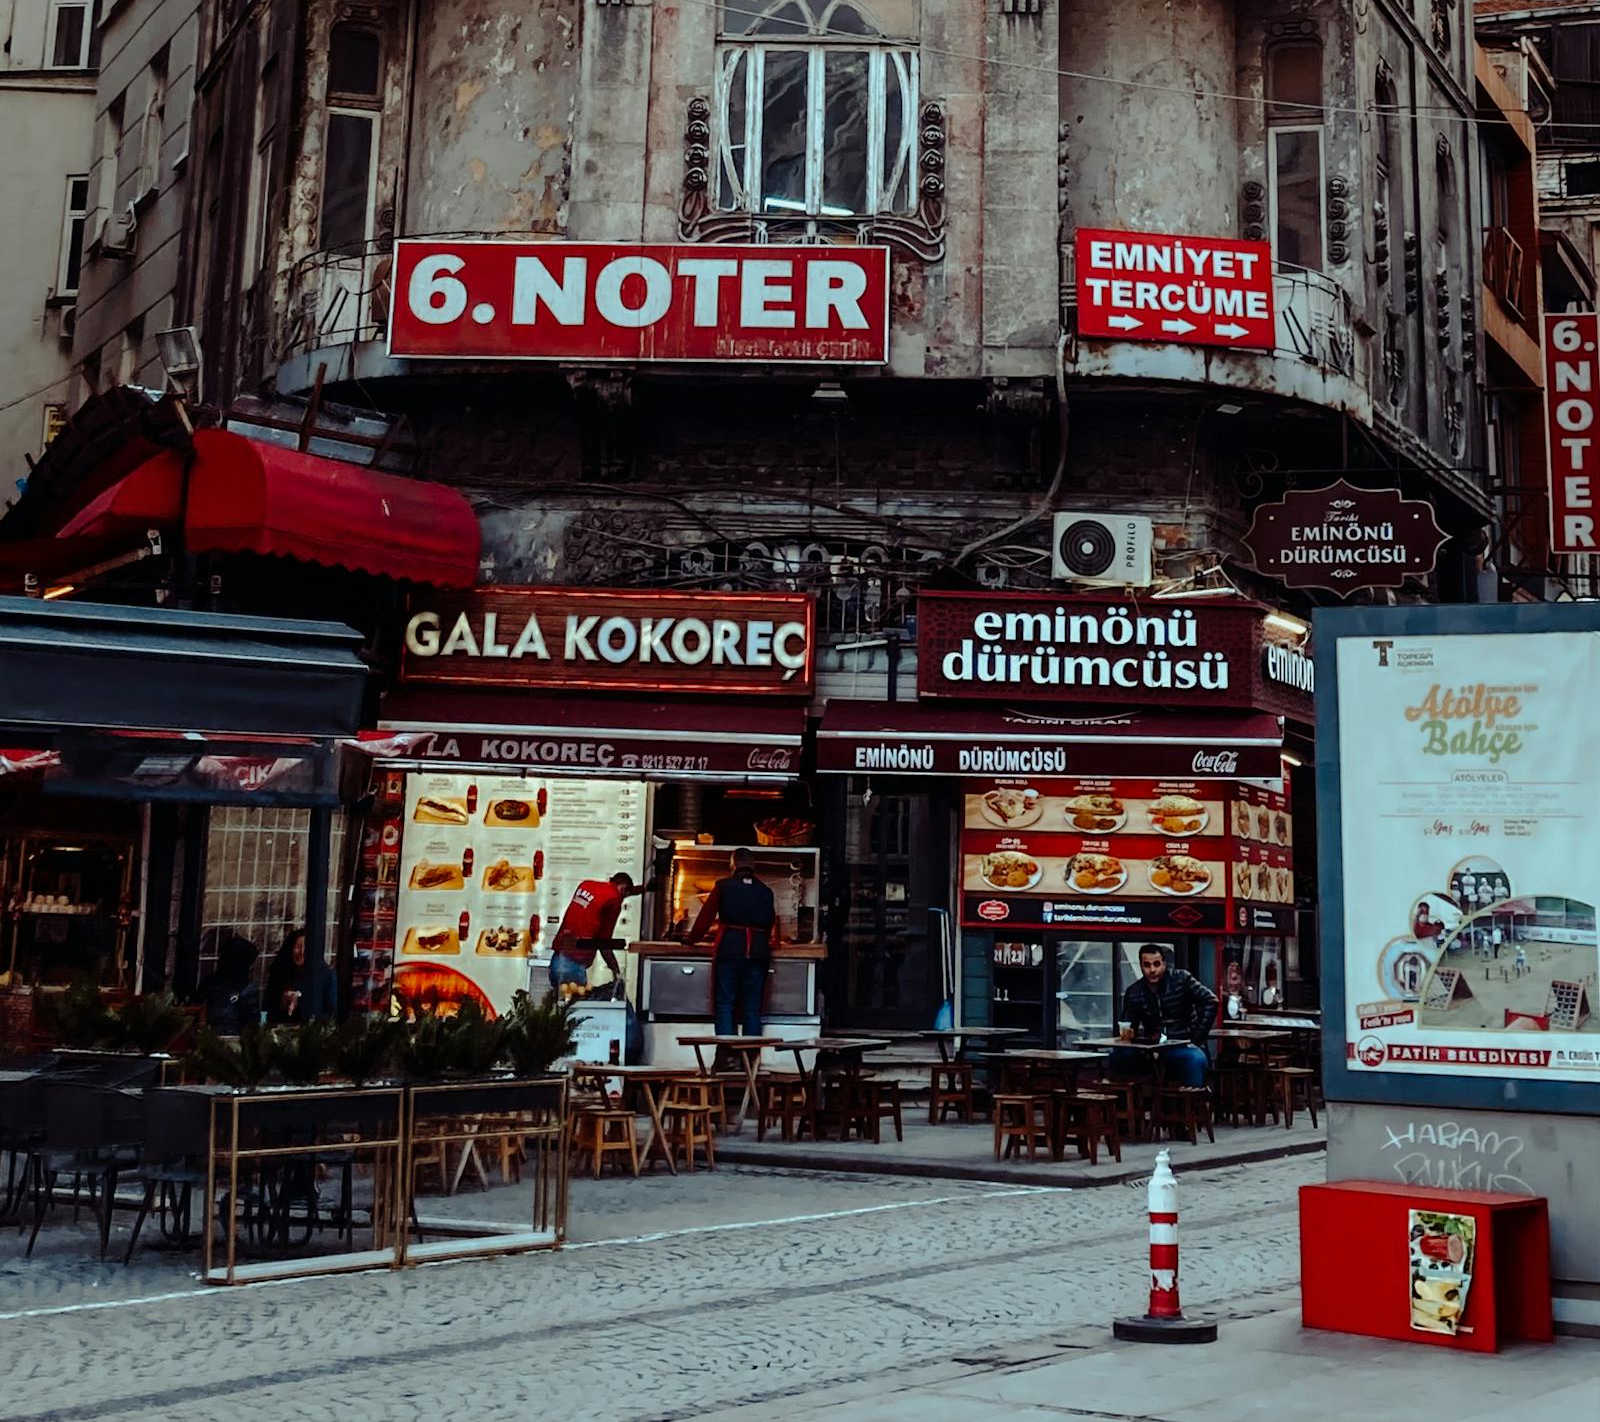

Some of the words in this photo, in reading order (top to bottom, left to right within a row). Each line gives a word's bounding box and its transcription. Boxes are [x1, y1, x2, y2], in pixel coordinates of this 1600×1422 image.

[1090, 240, 1258, 280] EMNİYET
[512, 256, 870, 329] NOTER
[1085, 278, 1269, 319] TERCÜME
[1291, 522, 1393, 541] EMİNÖNÜ
[1280, 545, 1407, 564] DÜRÜMCÜSÜ
[406, 611, 550, 660] GALA
[564, 615, 806, 681] KOKOREÇ
[974, 606, 1197, 648] eminönü
[942, 639, 1229, 690] dürümcüsü
[1404, 683, 1522, 729] Atölye
[481, 739, 615, 768] KOKOREÇ
[855, 743, 935, 770] EMİNÖNÜ
[958, 746, 1067, 773] DÜRÜMCÜSÜ
[1420, 720, 1524, 764] Bahçe
[1391, 1046, 1441, 1061] FATİH
[1447, 1046, 1546, 1065] BELEDİYESİ
